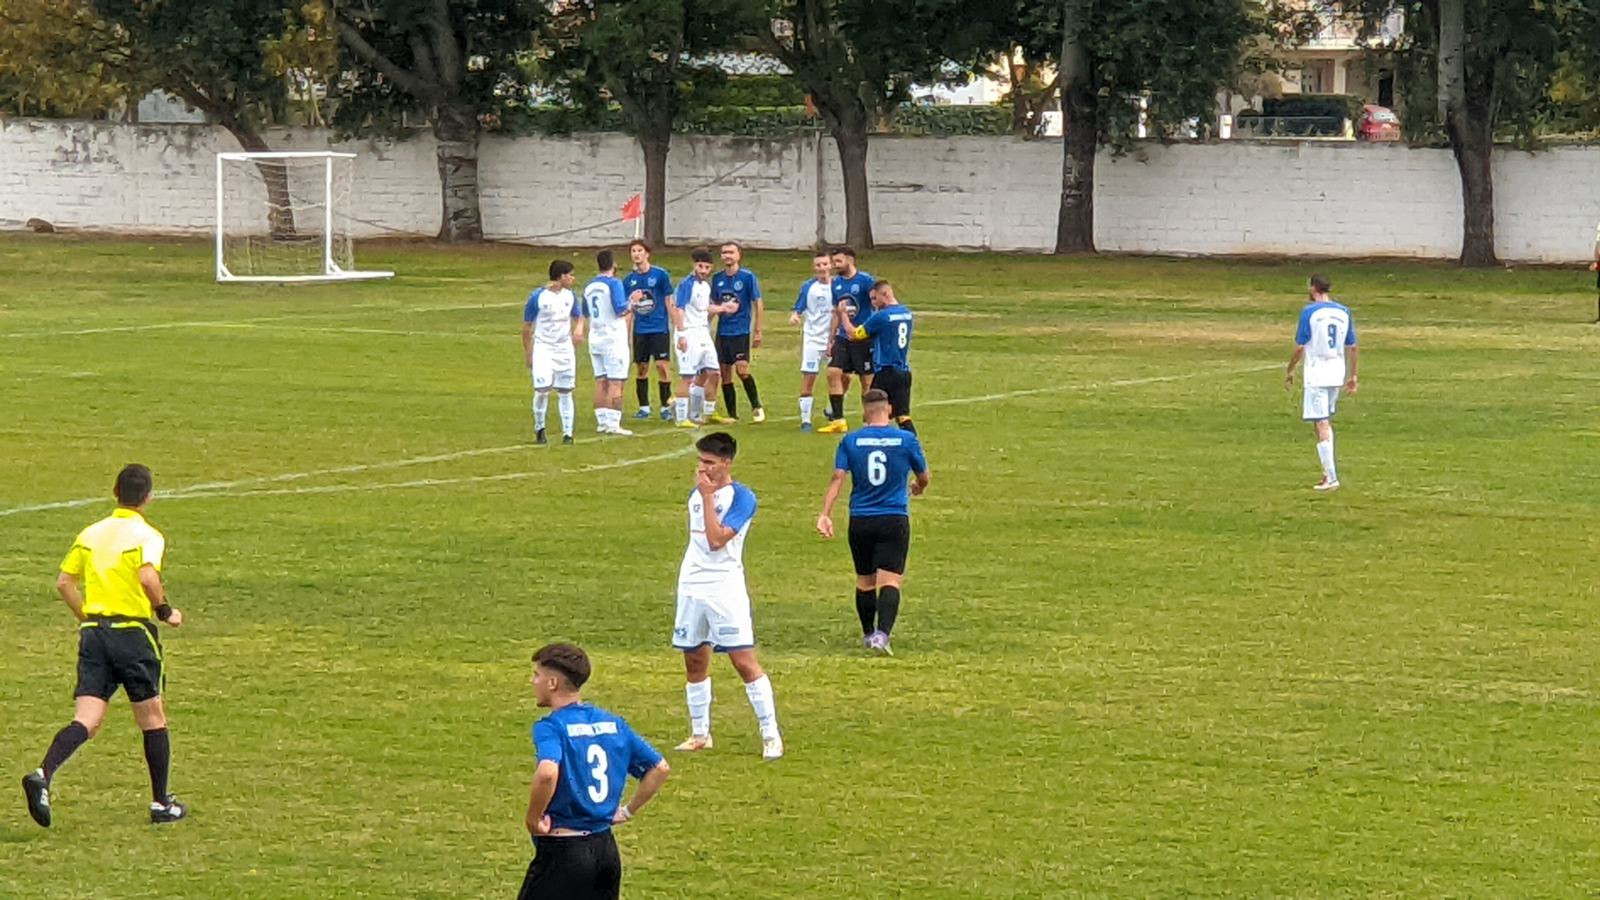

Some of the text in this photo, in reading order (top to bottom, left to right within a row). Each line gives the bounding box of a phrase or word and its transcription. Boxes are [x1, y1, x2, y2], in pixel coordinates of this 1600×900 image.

[591, 295, 600, 319] 5
[898, 322, 908, 349] 8
[1327, 323, 1338, 349] 9
[868, 450, 887, 486] 6
[587, 744, 609, 804] 3
